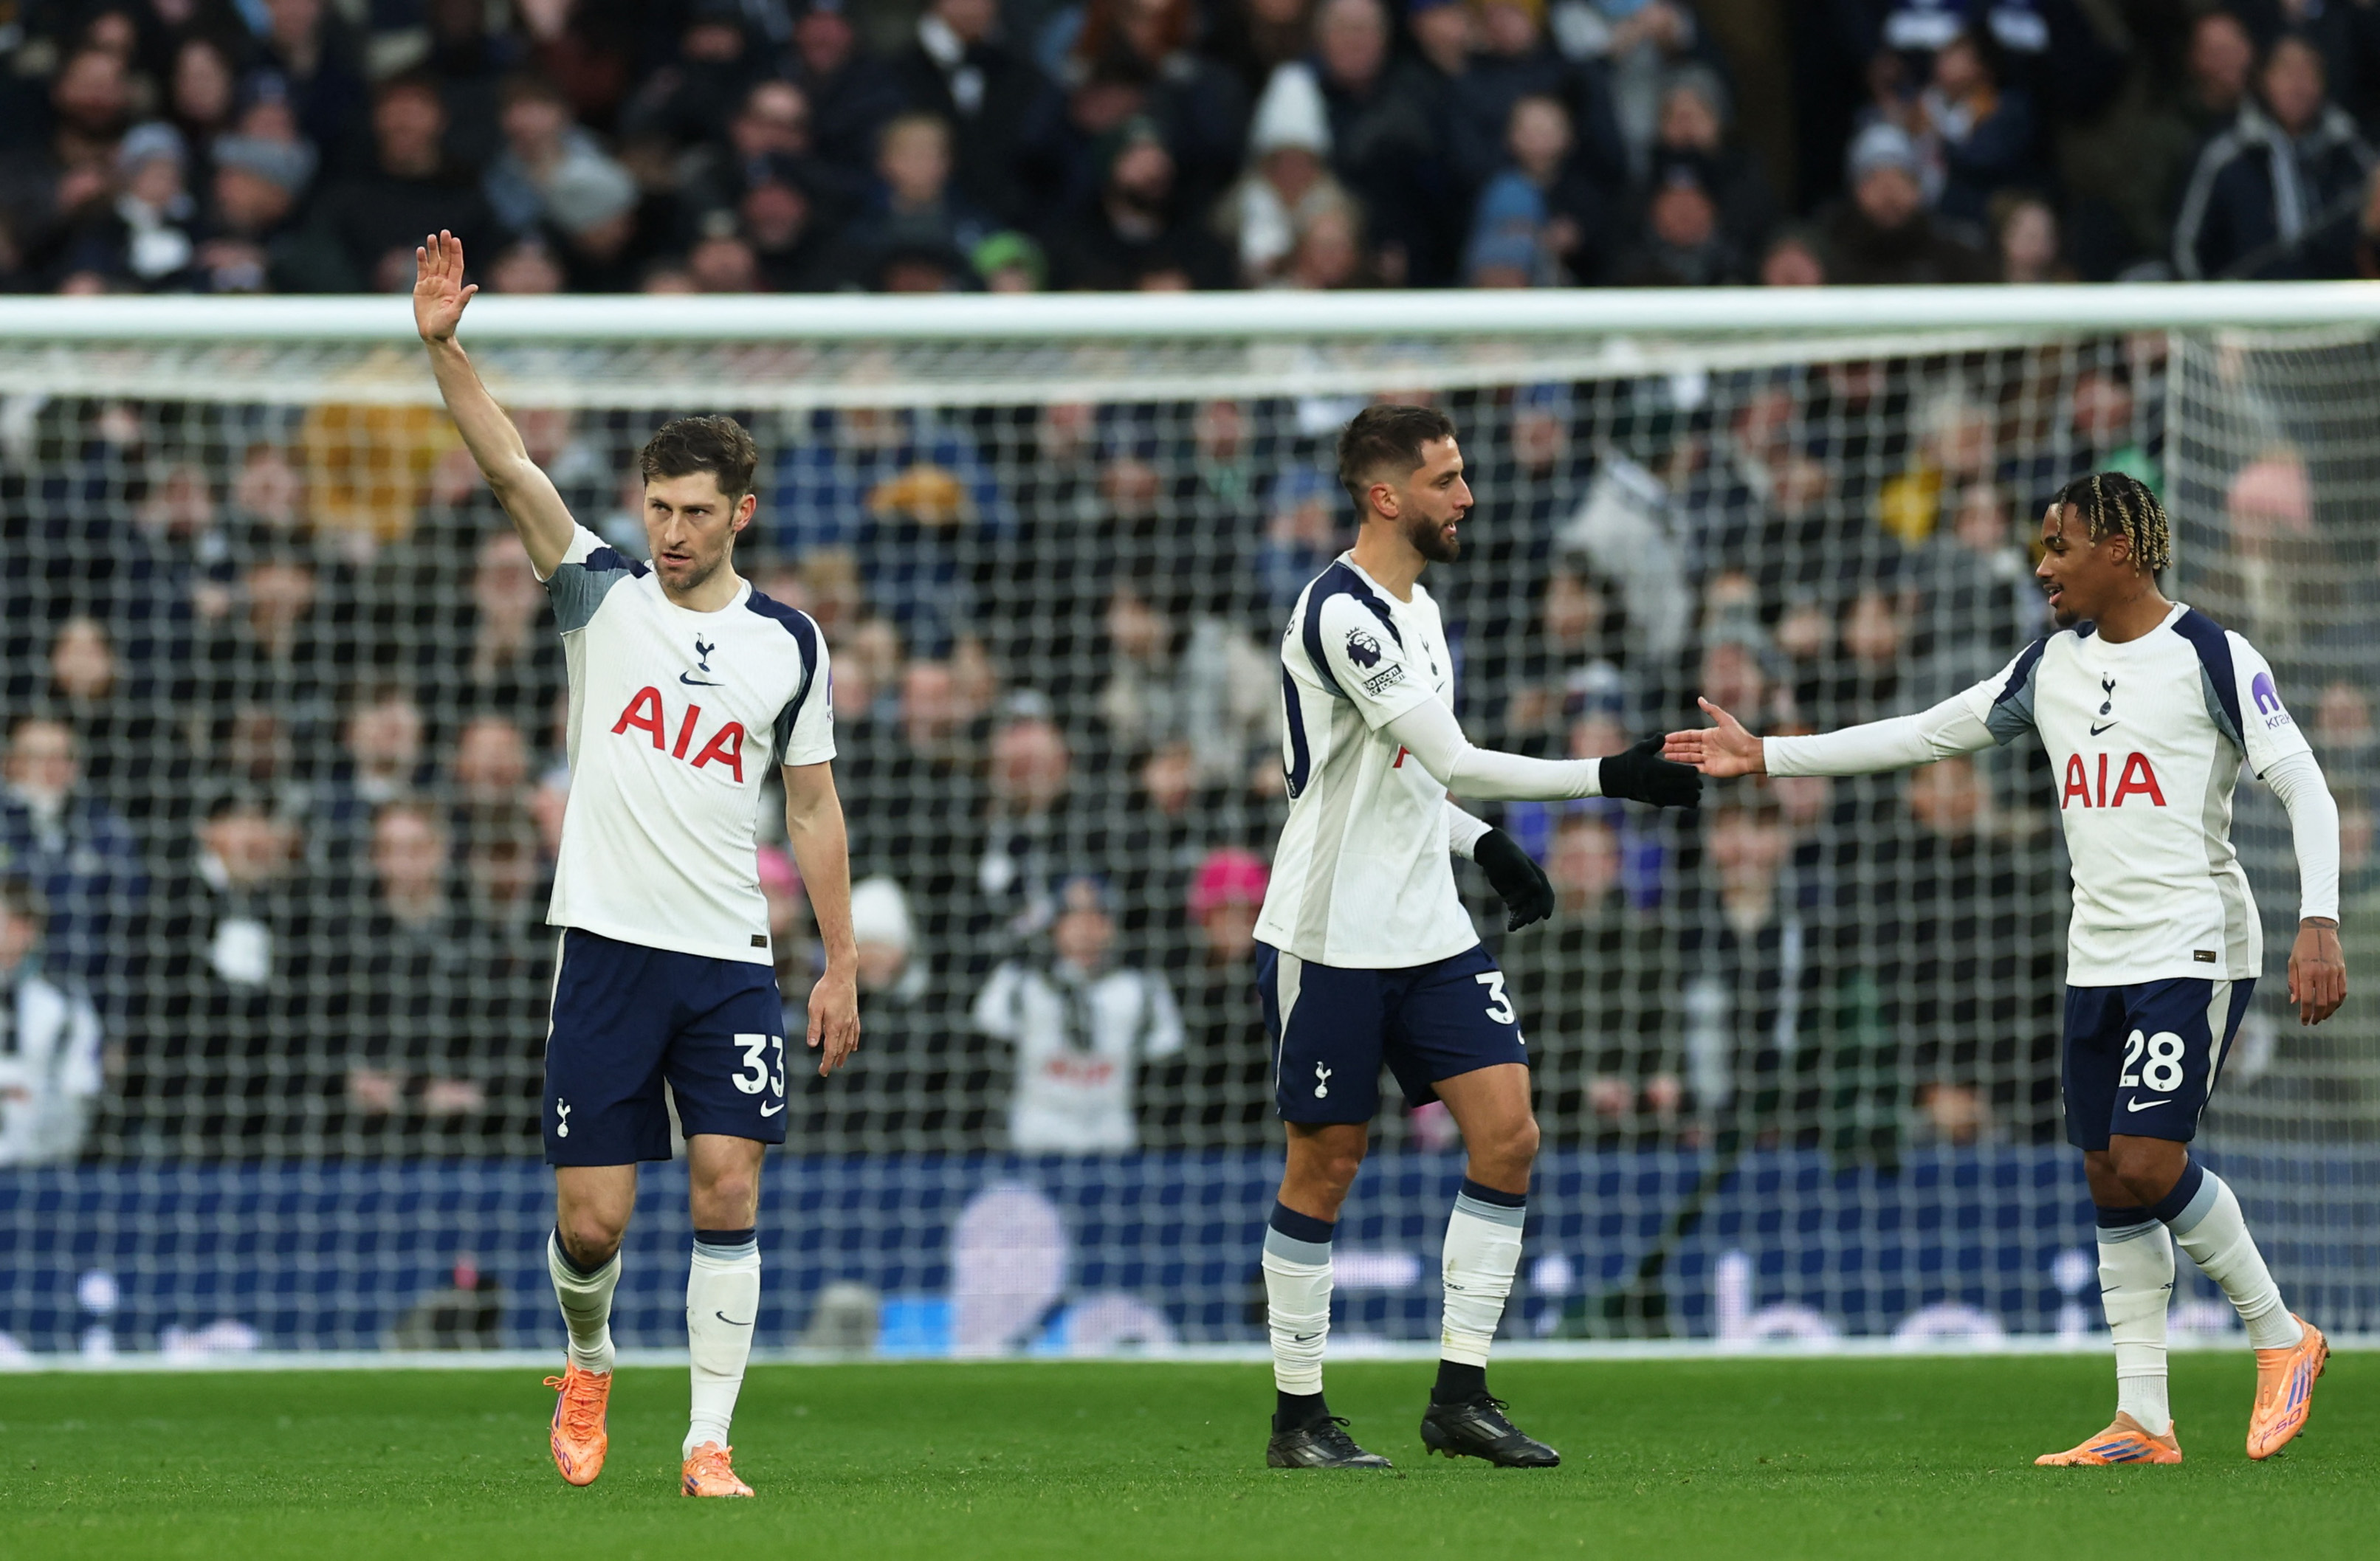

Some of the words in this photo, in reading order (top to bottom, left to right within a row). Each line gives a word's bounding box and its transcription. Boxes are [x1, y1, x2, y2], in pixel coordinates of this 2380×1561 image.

[1375, 666, 1399, 684] room
[611, 686, 744, 783] AIA
[2062, 752, 2167, 810] AIA
[732, 1034, 785, 1098] 33
[2119, 1029, 2185, 1092] 28
